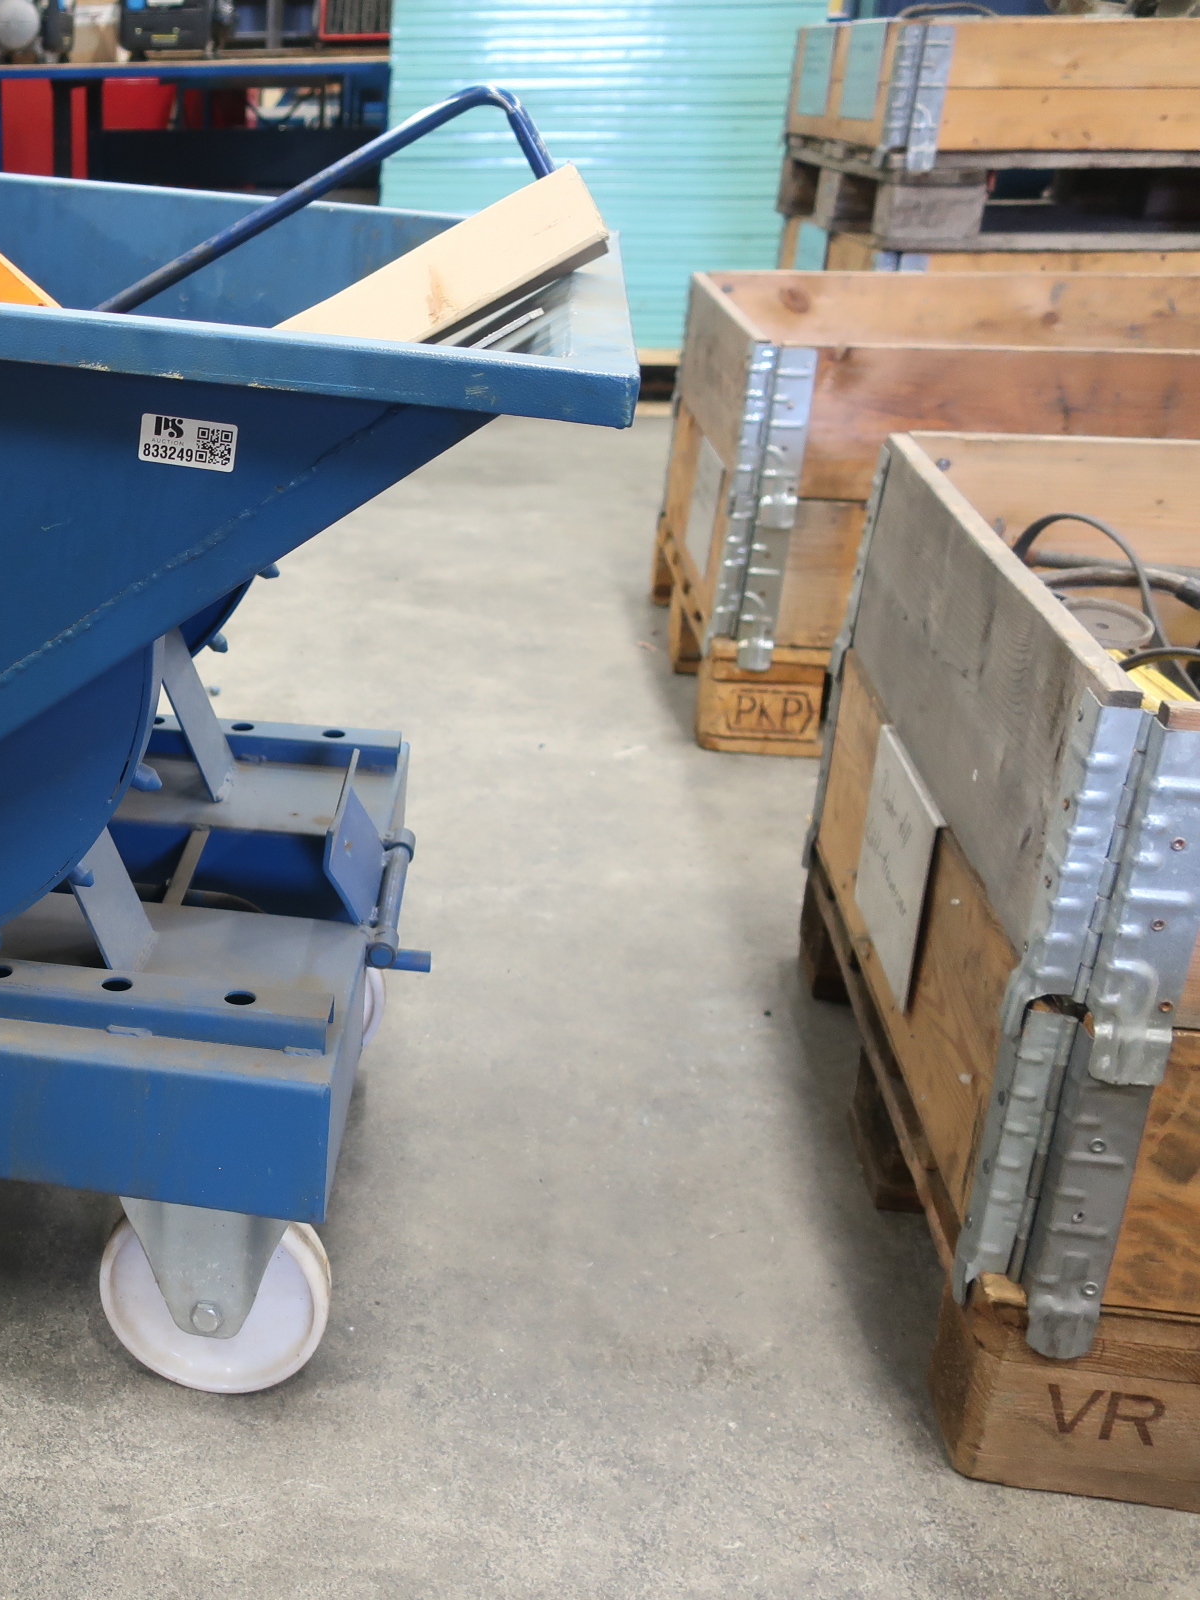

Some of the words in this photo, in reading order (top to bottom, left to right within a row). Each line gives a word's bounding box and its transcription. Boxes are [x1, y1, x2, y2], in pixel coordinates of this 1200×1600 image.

[154, 416, 184, 438] PS
[151, 438, 185, 446] AUCTION
[143, 443, 193, 462] 833249
[1048, 1384, 1166, 1446] VR
